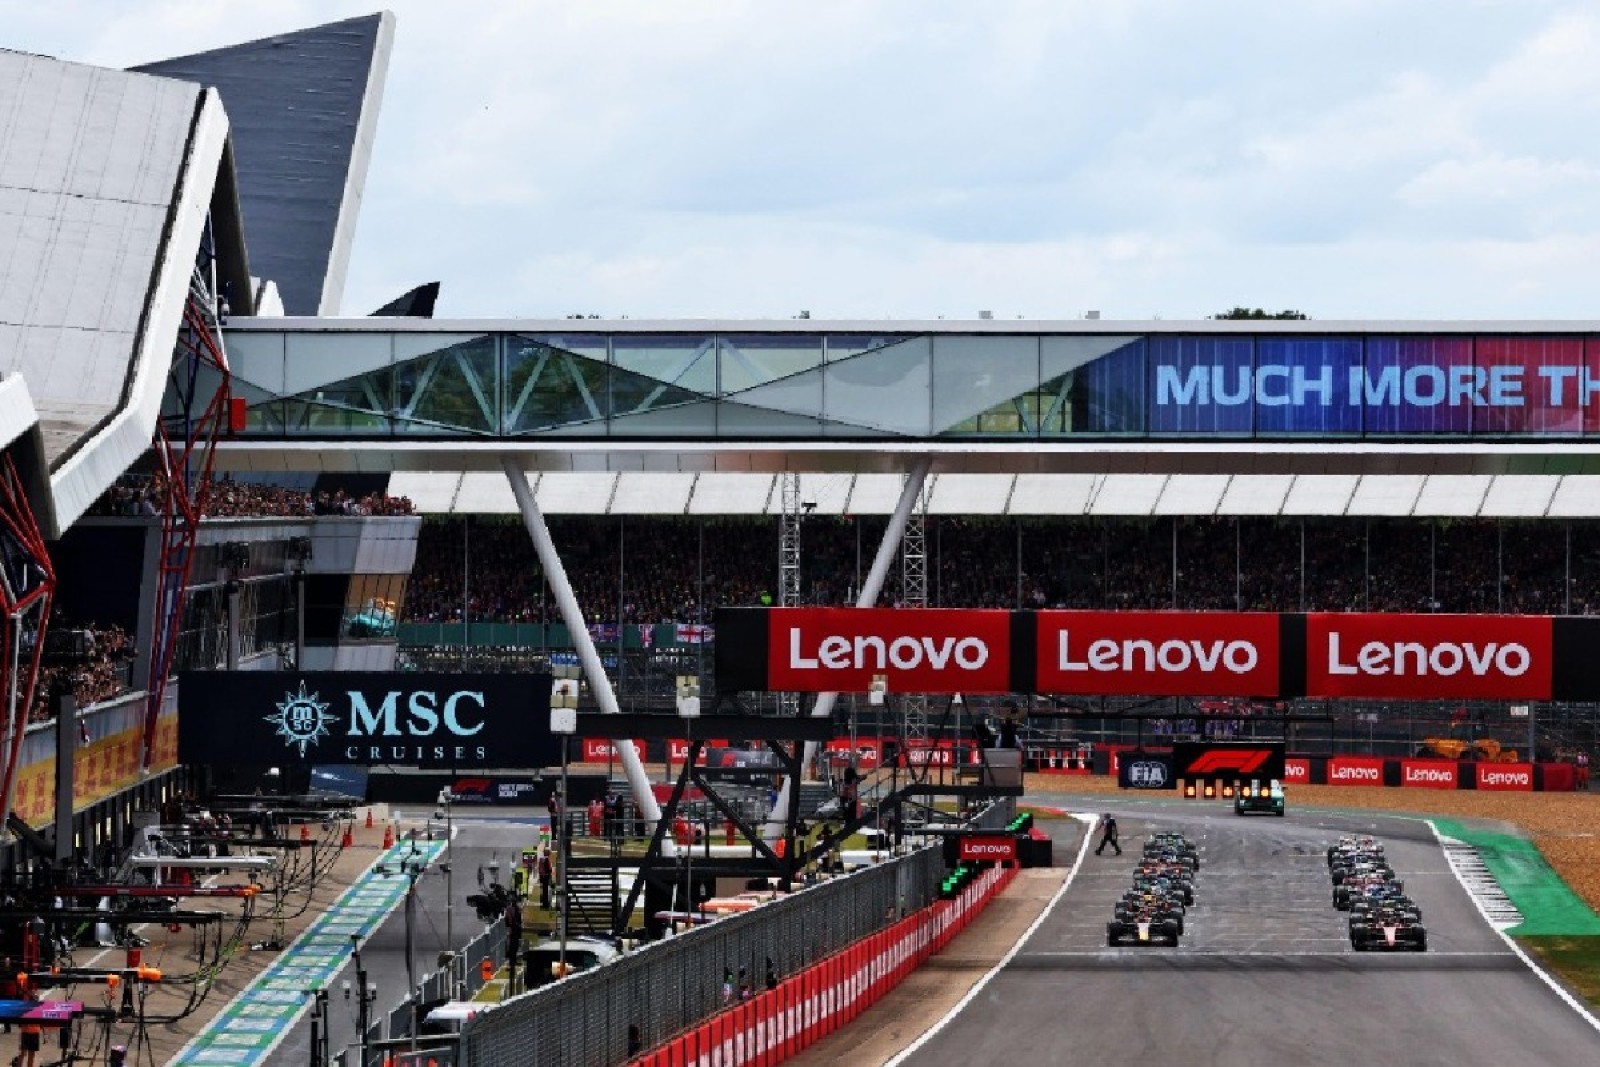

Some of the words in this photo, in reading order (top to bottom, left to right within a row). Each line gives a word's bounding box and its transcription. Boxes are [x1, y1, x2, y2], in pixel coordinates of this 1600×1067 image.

[1156, 365, 1333, 406] MUCH
[1348, 365, 1525, 406] MORE
[789, 627, 990, 671] Lenovo
[1058, 629, 1259, 674] Lenovo
[1327, 631, 1531, 677] Lenovo
[346, 690, 485, 736] MSC
[346, 746, 485, 760] CRUISES
[1331, 763, 1379, 780] Lenovo
[1406, 766, 1453, 782] Lenovo
[1481, 768, 1529, 785] Lenovo
[964, 843, 1012, 854] Lenovo
